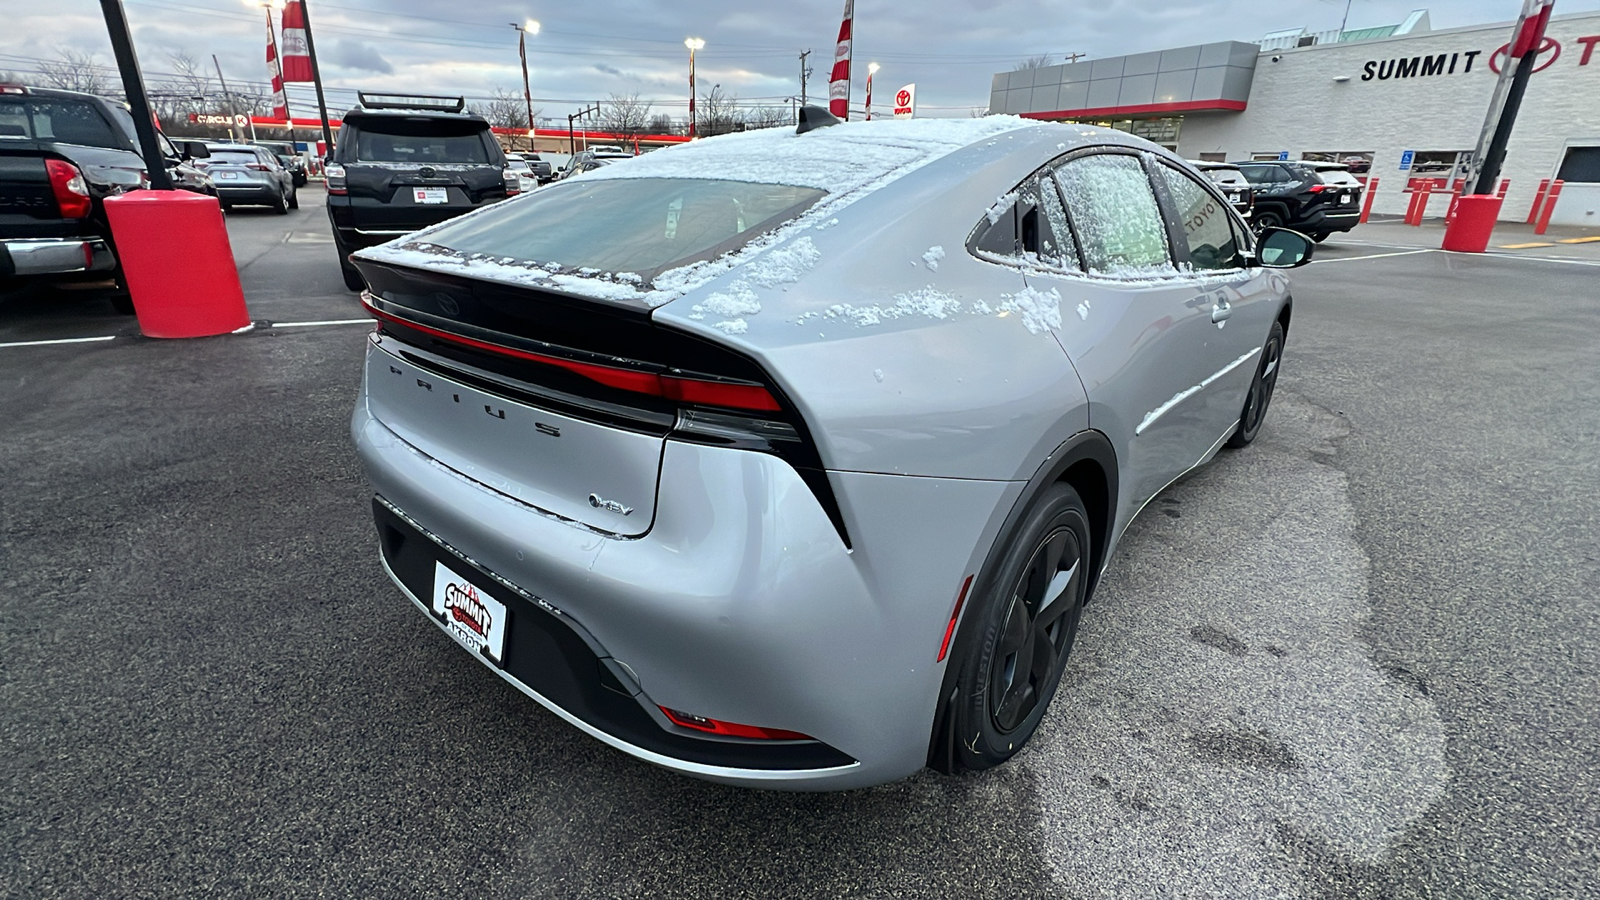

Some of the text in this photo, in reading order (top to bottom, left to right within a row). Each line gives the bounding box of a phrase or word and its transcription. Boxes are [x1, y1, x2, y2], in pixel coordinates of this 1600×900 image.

[1361, 50, 1482, 82] SUMMIT
[197, 114, 248, 126] CIRCLE K
[389, 365, 561, 437] PRIUS
[445, 583, 492, 640] SUMMIT
[462, 613, 483, 635] TOYOTA
[446, 620, 482, 654] AKRON
